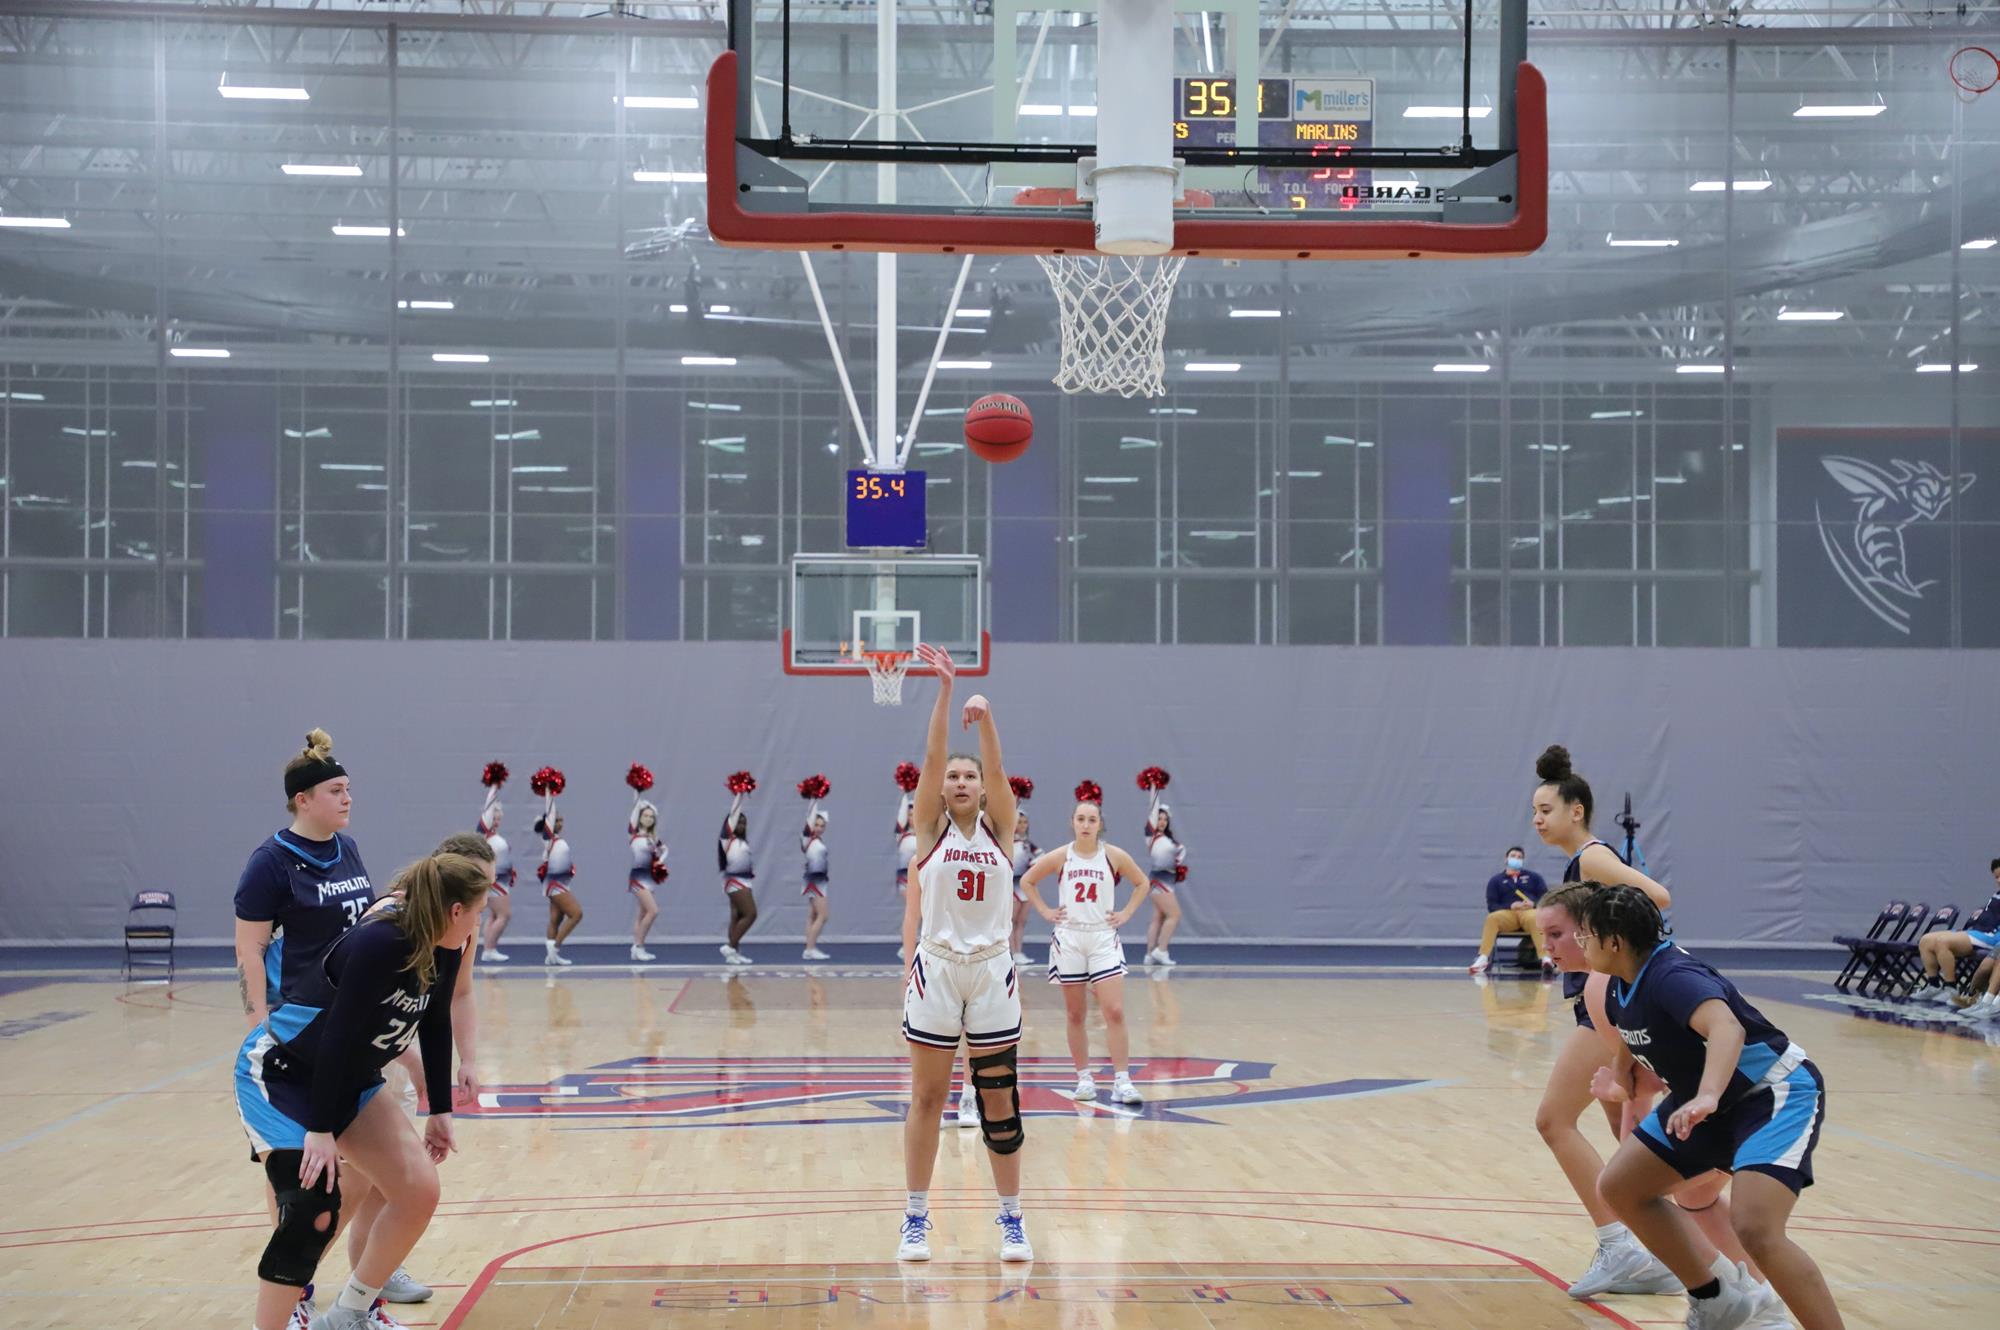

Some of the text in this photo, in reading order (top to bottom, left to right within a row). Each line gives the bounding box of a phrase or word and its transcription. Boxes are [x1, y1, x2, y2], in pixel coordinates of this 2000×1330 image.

[1324, 89, 1369, 106] miller's
[1296, 123, 1358, 140] MARLINS
[1283, 183, 1313, 194] T.O.L.
[856, 477, 905, 499] 35.4
[943, 847, 998, 866] HORNETS
[1067, 869, 1105, 881] HORNETS
[957, 869, 986, 901] 31
[1074, 882, 1098, 903] 24
[371, 1018, 420, 1052] 24
